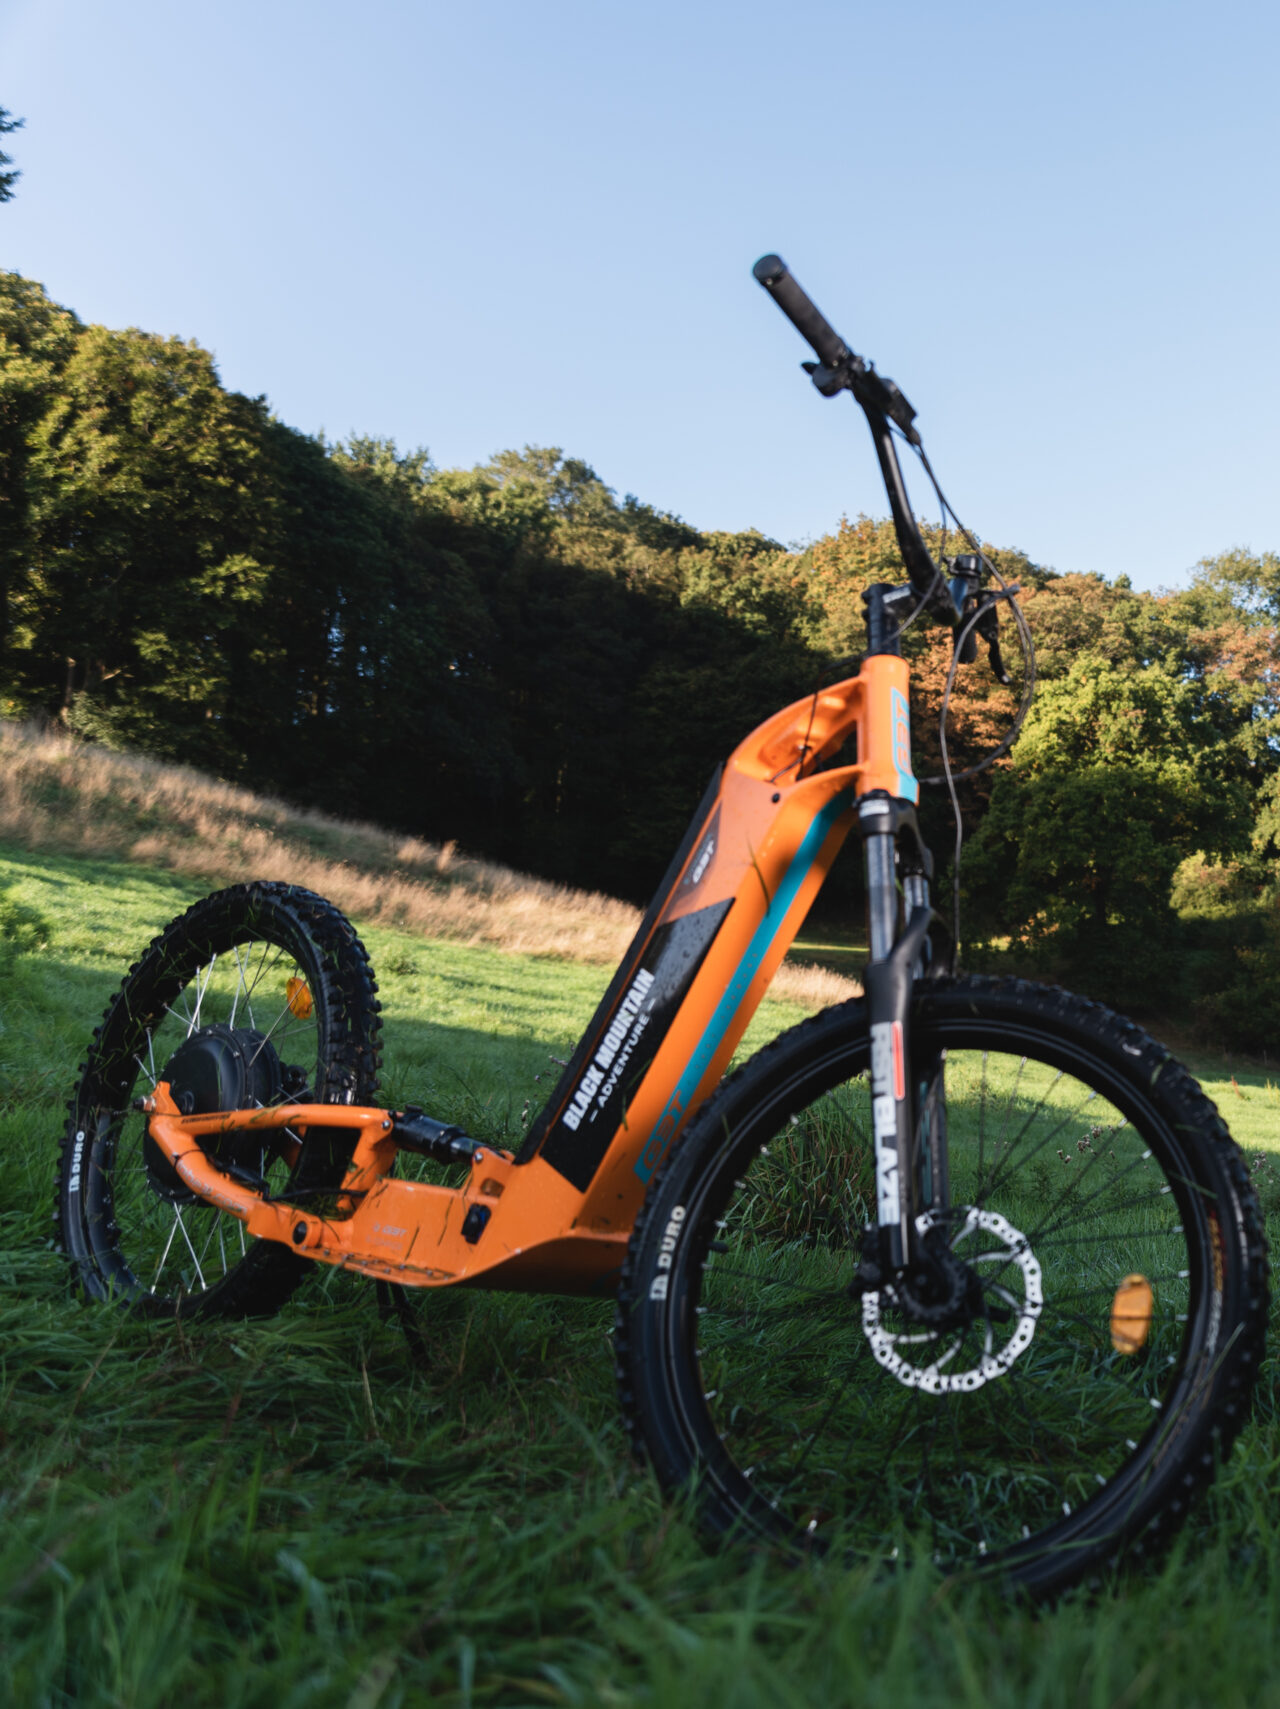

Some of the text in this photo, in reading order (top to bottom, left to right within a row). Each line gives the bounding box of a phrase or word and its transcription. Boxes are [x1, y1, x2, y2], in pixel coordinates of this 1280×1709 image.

[562, 967, 655, 1131] BLACK MOUNTAIN
[598, 1012, 650, 1109] ADVENTURE
[72, 1130, 85, 1174] DURO
[873, 1095, 901, 1226] BLAZE
[657, 1205, 686, 1269] DURO
